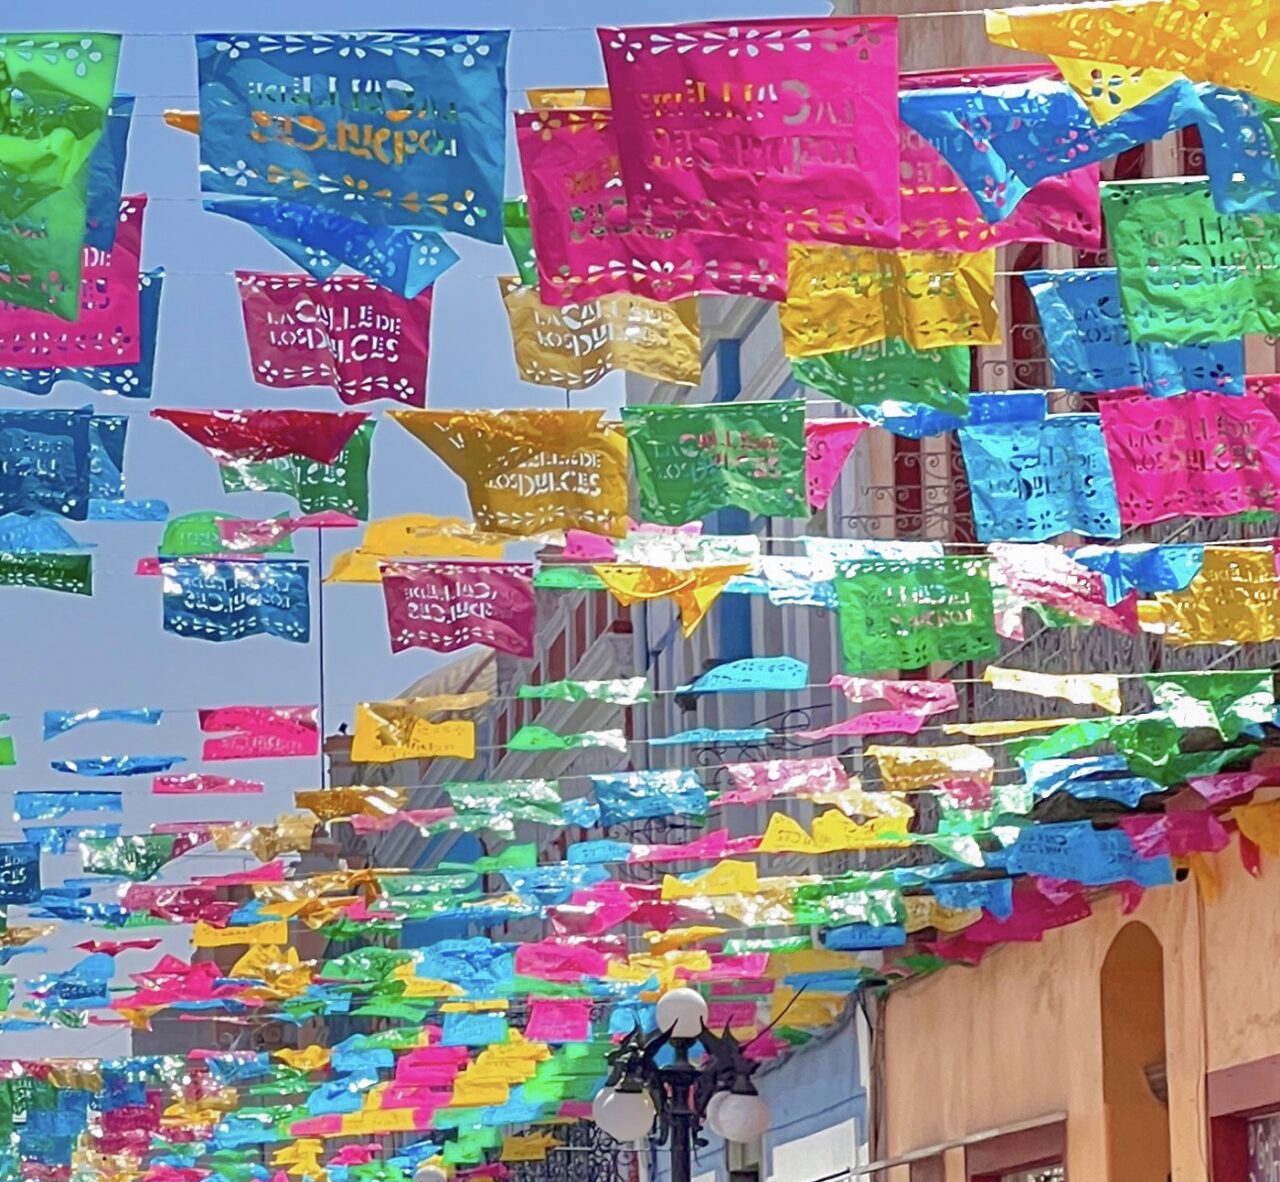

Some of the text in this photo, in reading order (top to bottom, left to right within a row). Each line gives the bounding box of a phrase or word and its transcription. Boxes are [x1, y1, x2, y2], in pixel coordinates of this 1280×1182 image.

[267, 300, 401, 335] LA CALLE DE
[534, 311, 561, 326] LA
[270, 328, 399, 363] LOS DULCES
[536, 330, 572, 349] LOS
[519, 471, 602, 497] DULCES
